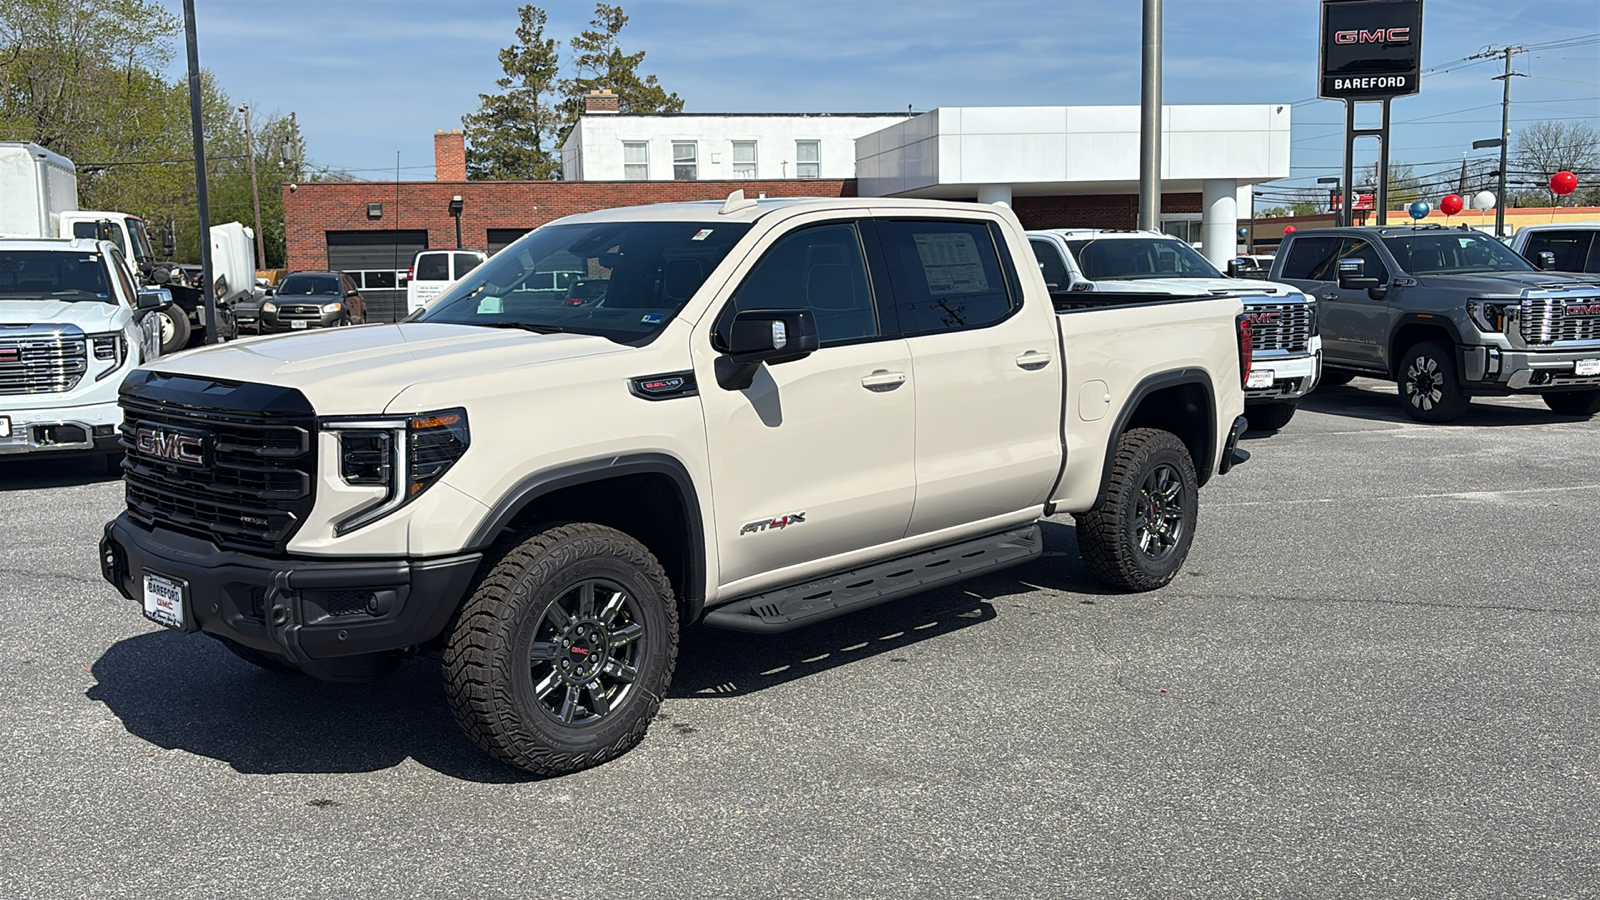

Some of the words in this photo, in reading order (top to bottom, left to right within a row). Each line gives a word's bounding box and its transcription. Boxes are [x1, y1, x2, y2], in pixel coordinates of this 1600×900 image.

[1335, 27, 1410, 44] GMC
[1334, 76, 1406, 90] BAREFORD
[136, 427, 204, 464] GMC
[740, 511, 807, 536] AT4X
[148, 581, 180, 603] BAREFORD
[156, 598, 174, 611] GMC
[571, 646, 589, 655] GMC
